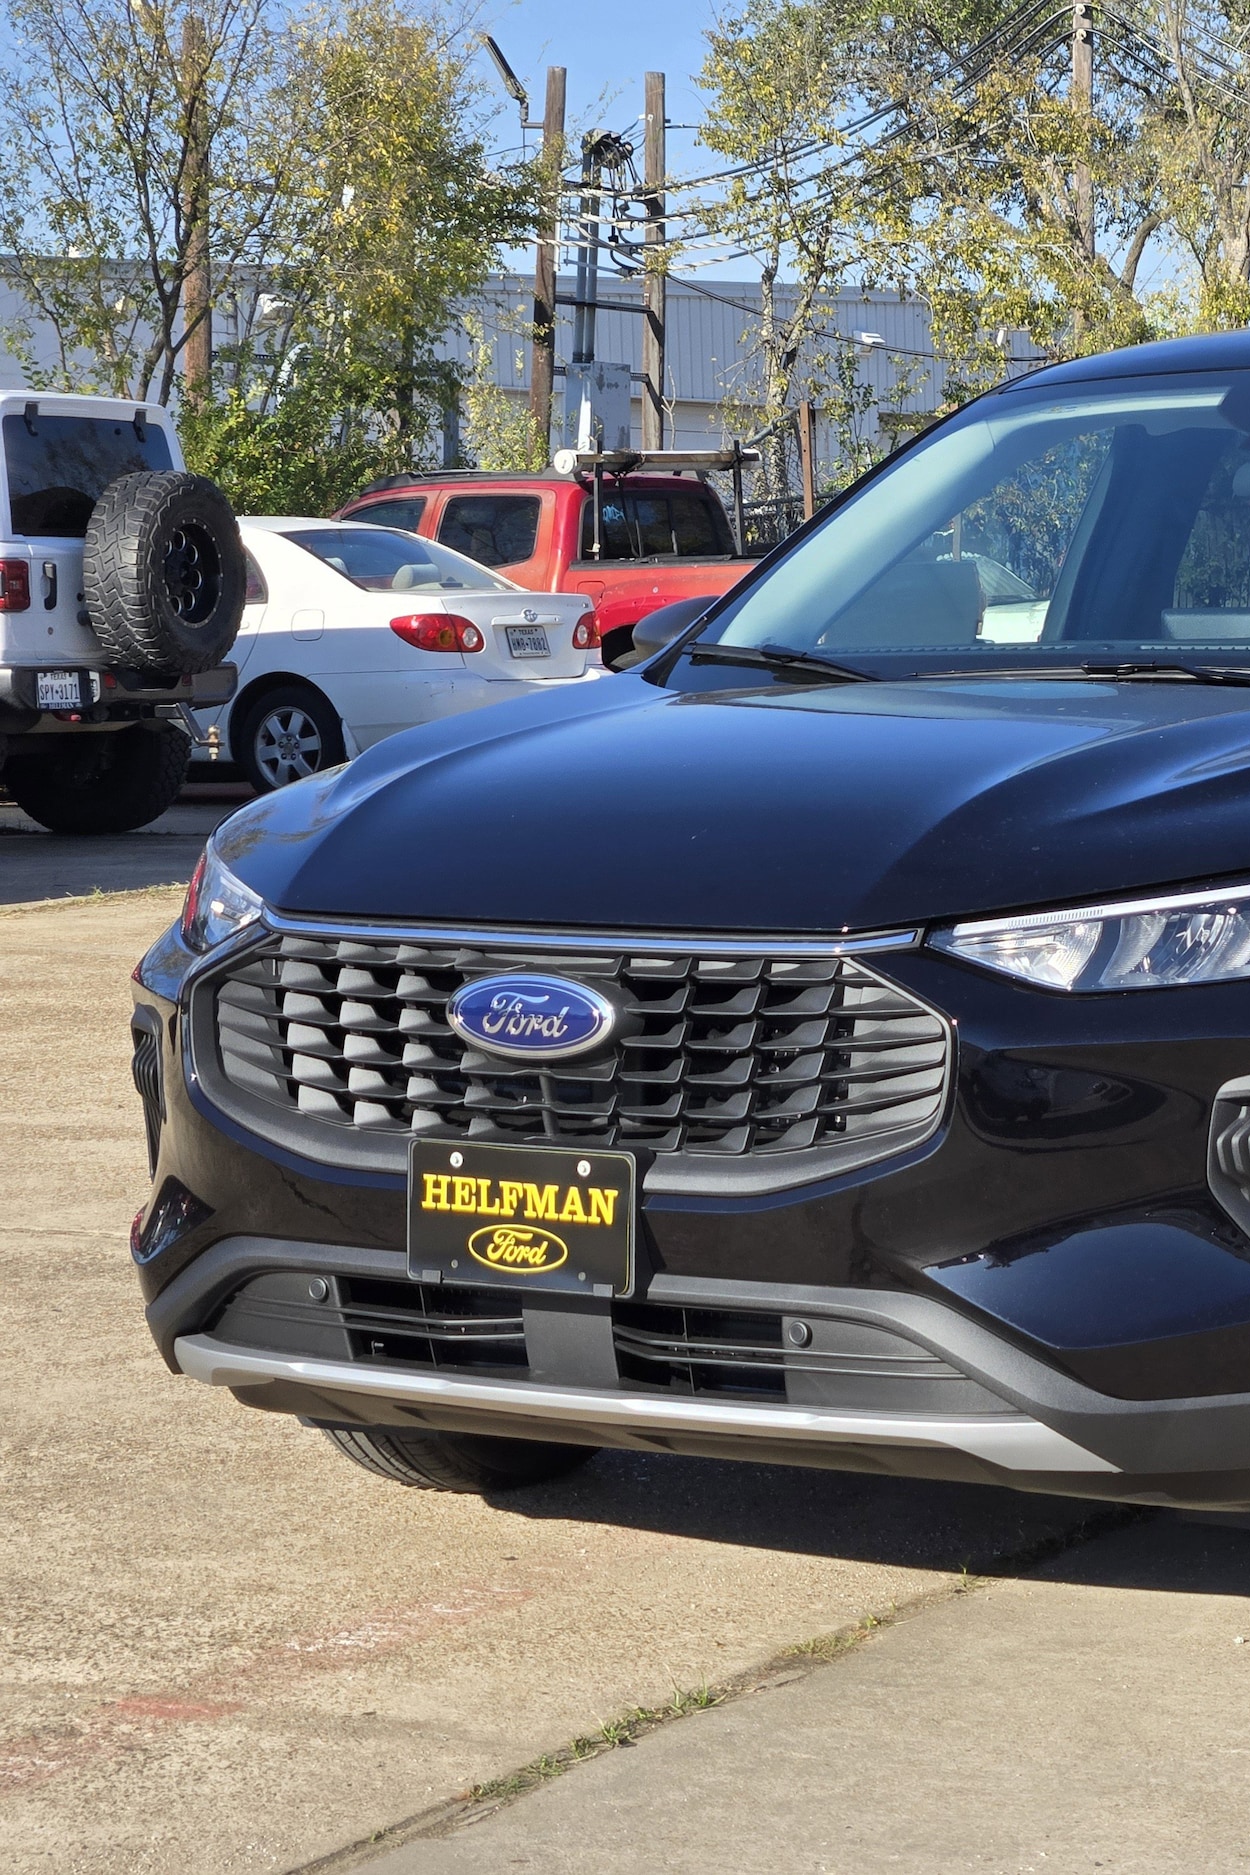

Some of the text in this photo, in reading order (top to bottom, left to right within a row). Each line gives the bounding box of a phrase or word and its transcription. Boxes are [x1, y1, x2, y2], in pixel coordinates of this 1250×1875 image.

[483, 990, 568, 1038] Ford
[421, 1173, 619, 1226] HELFMAN
[487, 1228, 549, 1266] Ford
